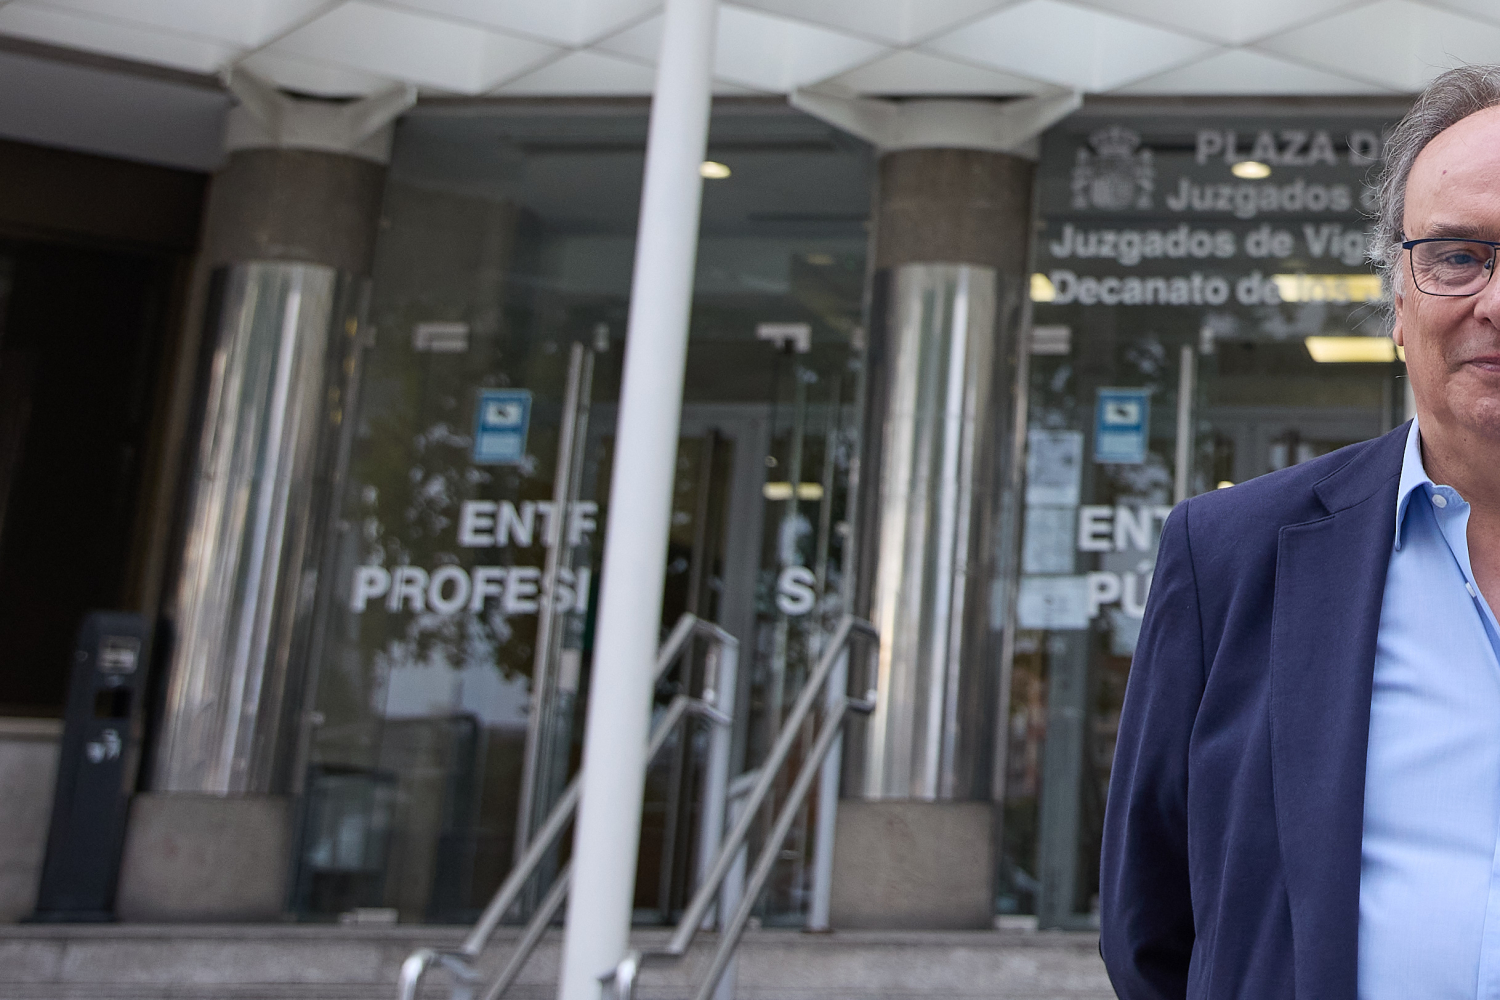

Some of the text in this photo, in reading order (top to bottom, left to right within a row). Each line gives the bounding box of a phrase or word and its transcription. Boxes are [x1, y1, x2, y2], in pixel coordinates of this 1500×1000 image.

[1196, 129, 1338, 167] PLAZA
[1166, 177, 1350, 218] Juzgados
[1051, 223, 1236, 266] Juzgados
[1244, 223, 1295, 259] de
[1301, 222, 1376, 267] Vig
[1051, 270, 1230, 306] Decanato
[1235, 270, 1280, 306] de
